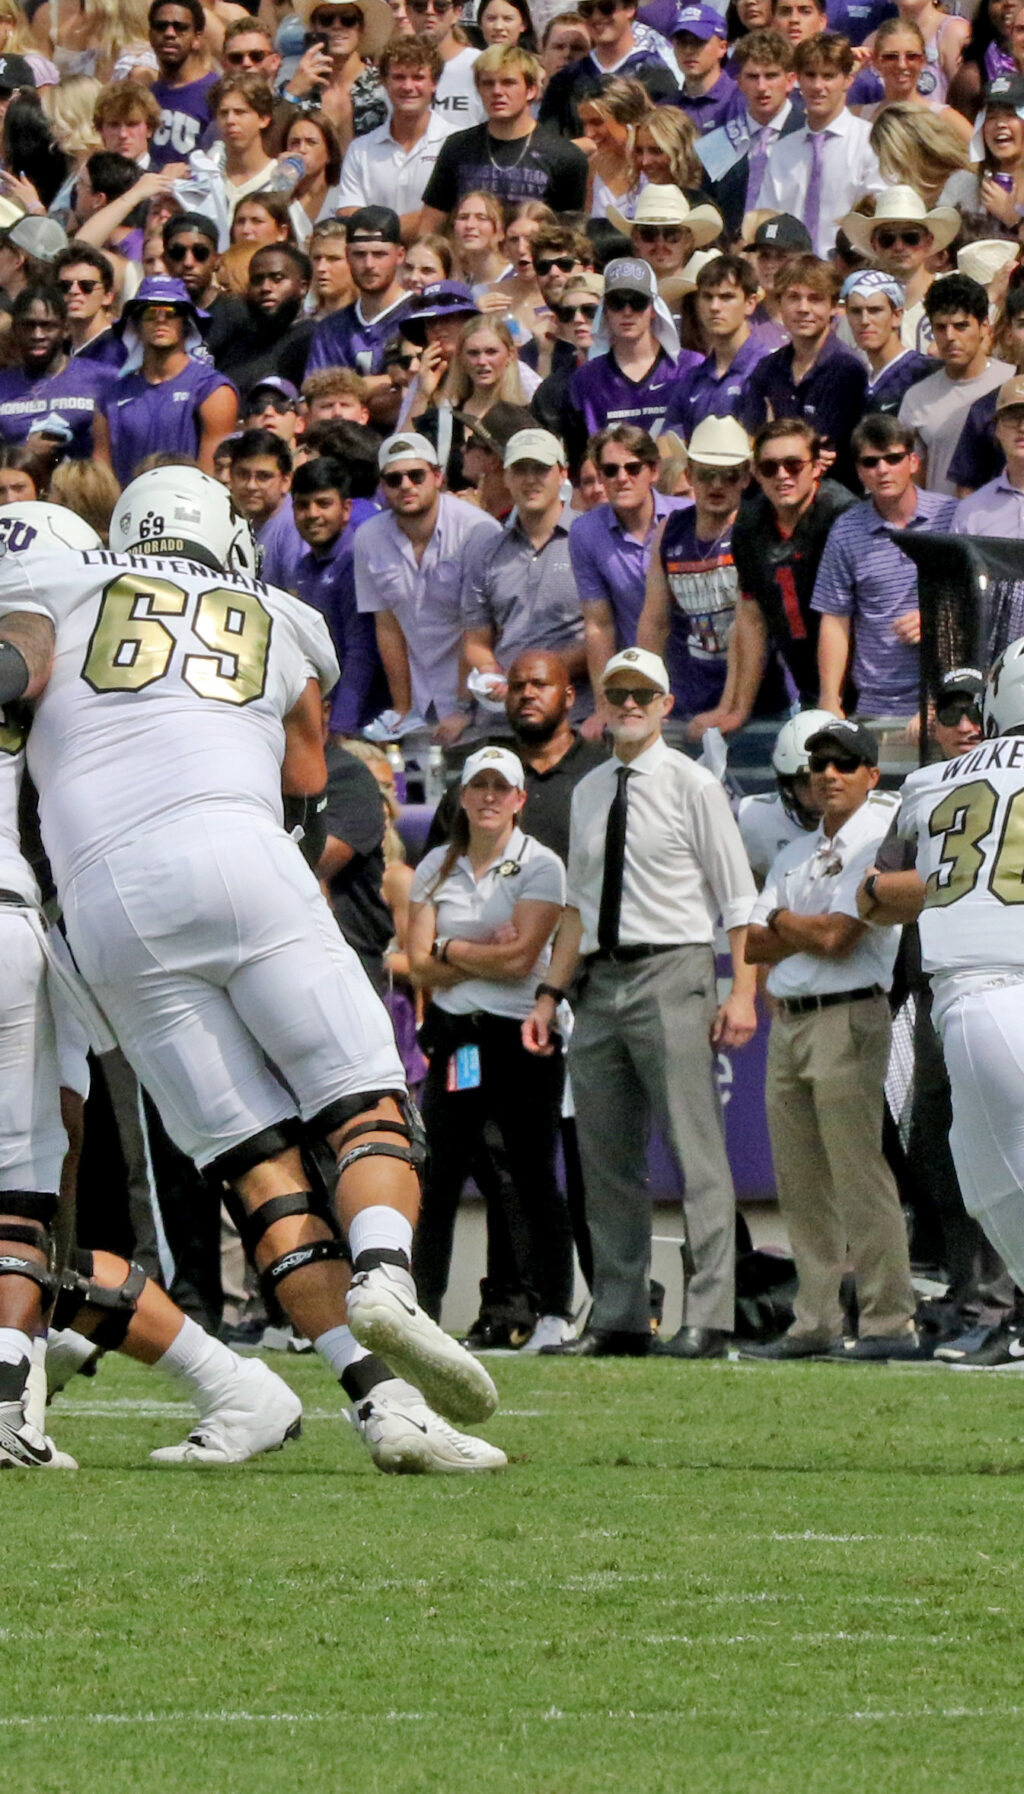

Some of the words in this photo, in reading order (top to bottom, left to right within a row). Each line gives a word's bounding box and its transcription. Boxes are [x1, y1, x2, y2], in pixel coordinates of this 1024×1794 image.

[609, 263, 645, 283] TCU
[0, 399, 47, 415] ORNED
[50, 397, 94, 411] FROGS
[140, 516, 165, 539] 69
[128, 538, 184, 554] OLORADO
[775, 567, 804, 639] 1
[81, 572, 273, 706] 69
